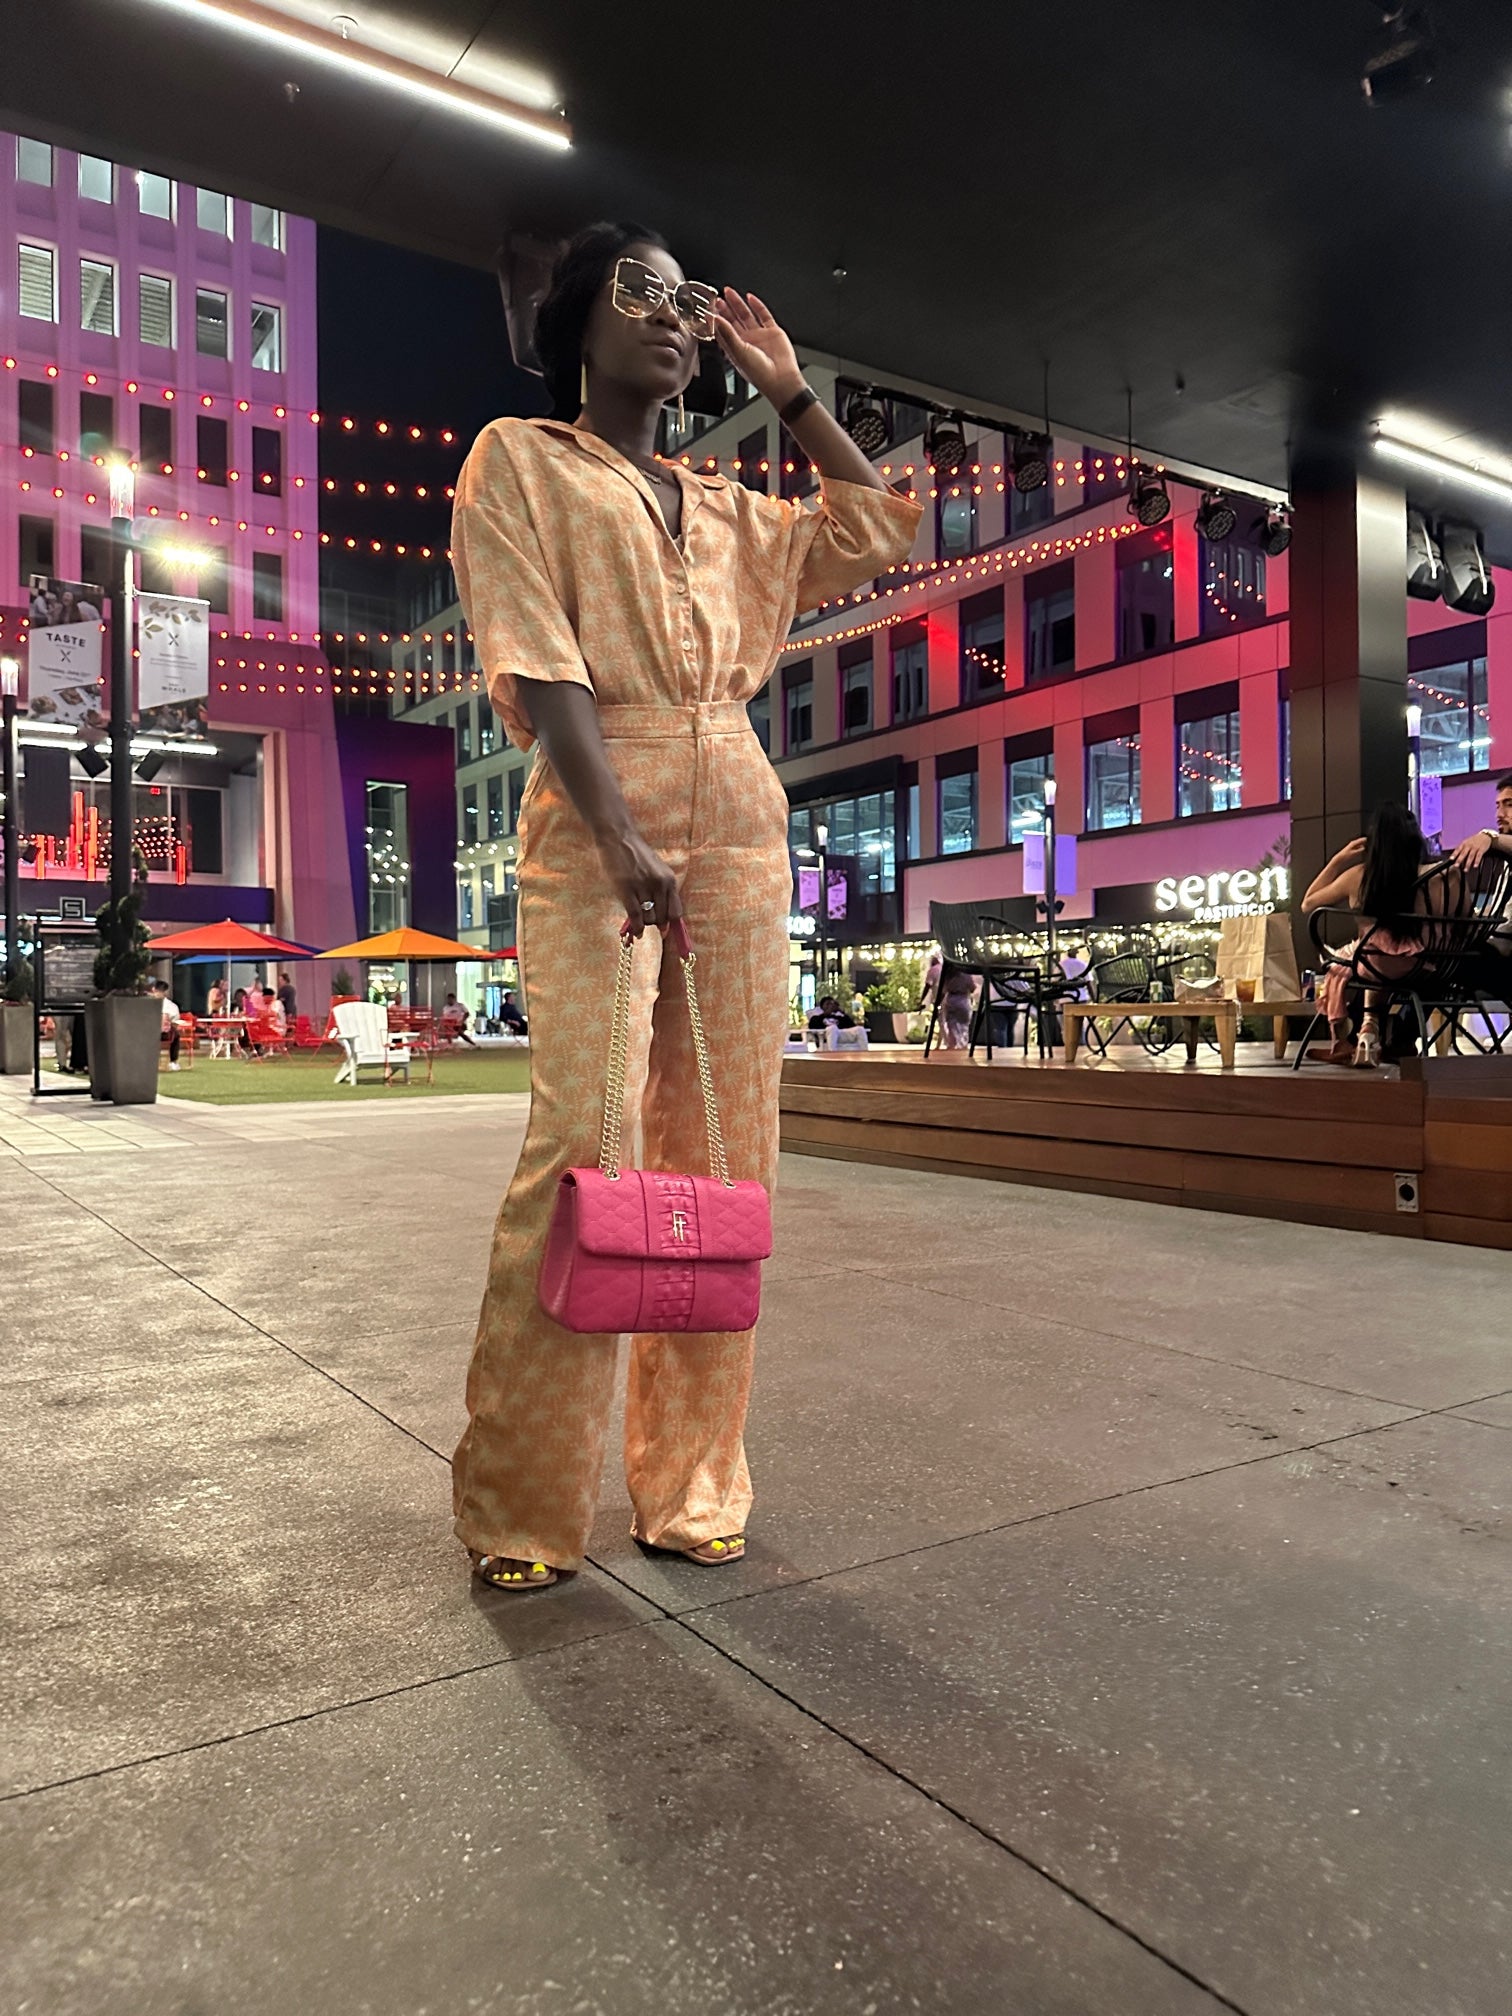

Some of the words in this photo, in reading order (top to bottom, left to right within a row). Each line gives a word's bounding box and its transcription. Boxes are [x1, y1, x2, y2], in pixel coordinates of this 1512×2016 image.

[46, 632, 86, 648] TASTE
[1155, 866, 1288, 912] seren
[1194, 901, 1276, 921] PASTIFICIO
